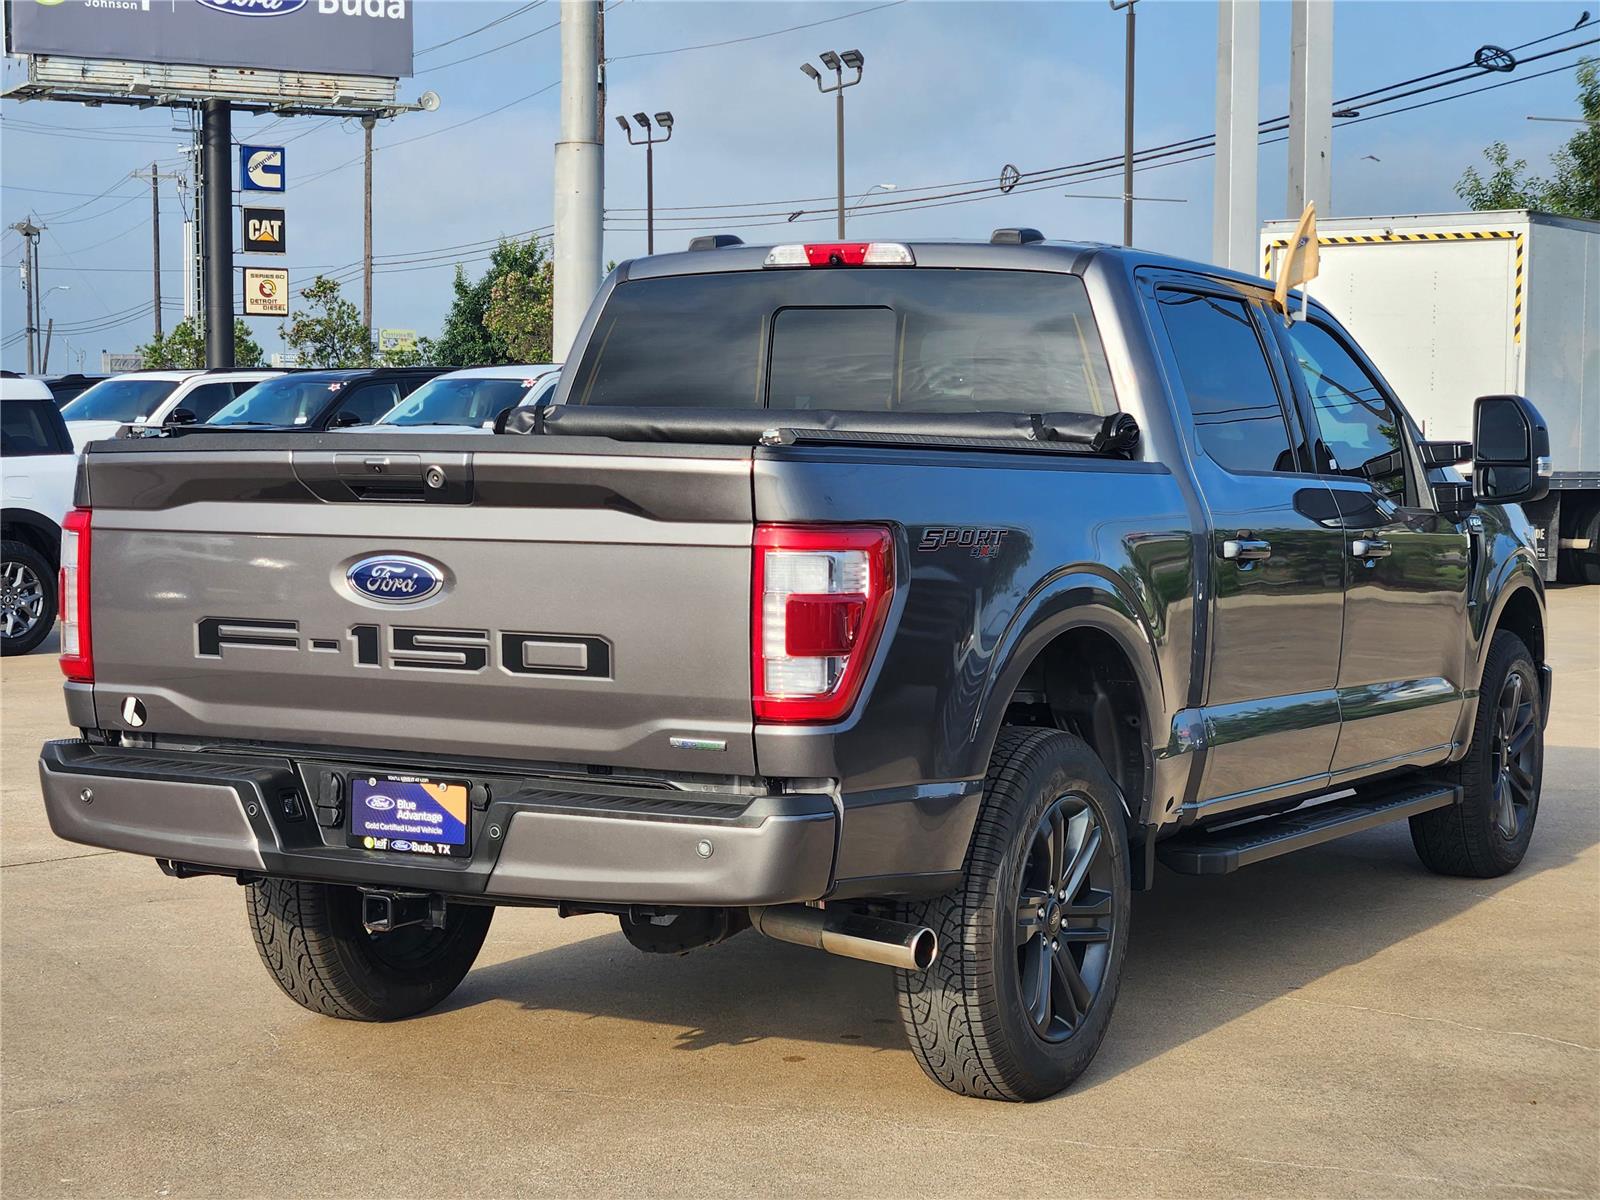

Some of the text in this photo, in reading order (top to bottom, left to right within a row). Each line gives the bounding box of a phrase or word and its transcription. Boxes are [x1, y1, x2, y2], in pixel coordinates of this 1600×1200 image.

[84, 0, 138, 10] Johnson
[318, 0, 406, 19] Buda
[248, 151, 278, 173] Cummins
[248, 219, 282, 242] CAT
[917, 526, 1008, 552] SPORT
[366, 565, 419, 593] Ford
[193, 615, 616, 682] F-150
[397, 799, 417, 810] Blue
[396, 810, 443, 823] Advantage
[365, 821, 443, 835] Gold Certified Used Vehicle
[411, 842, 451, 855] Buda, TX
